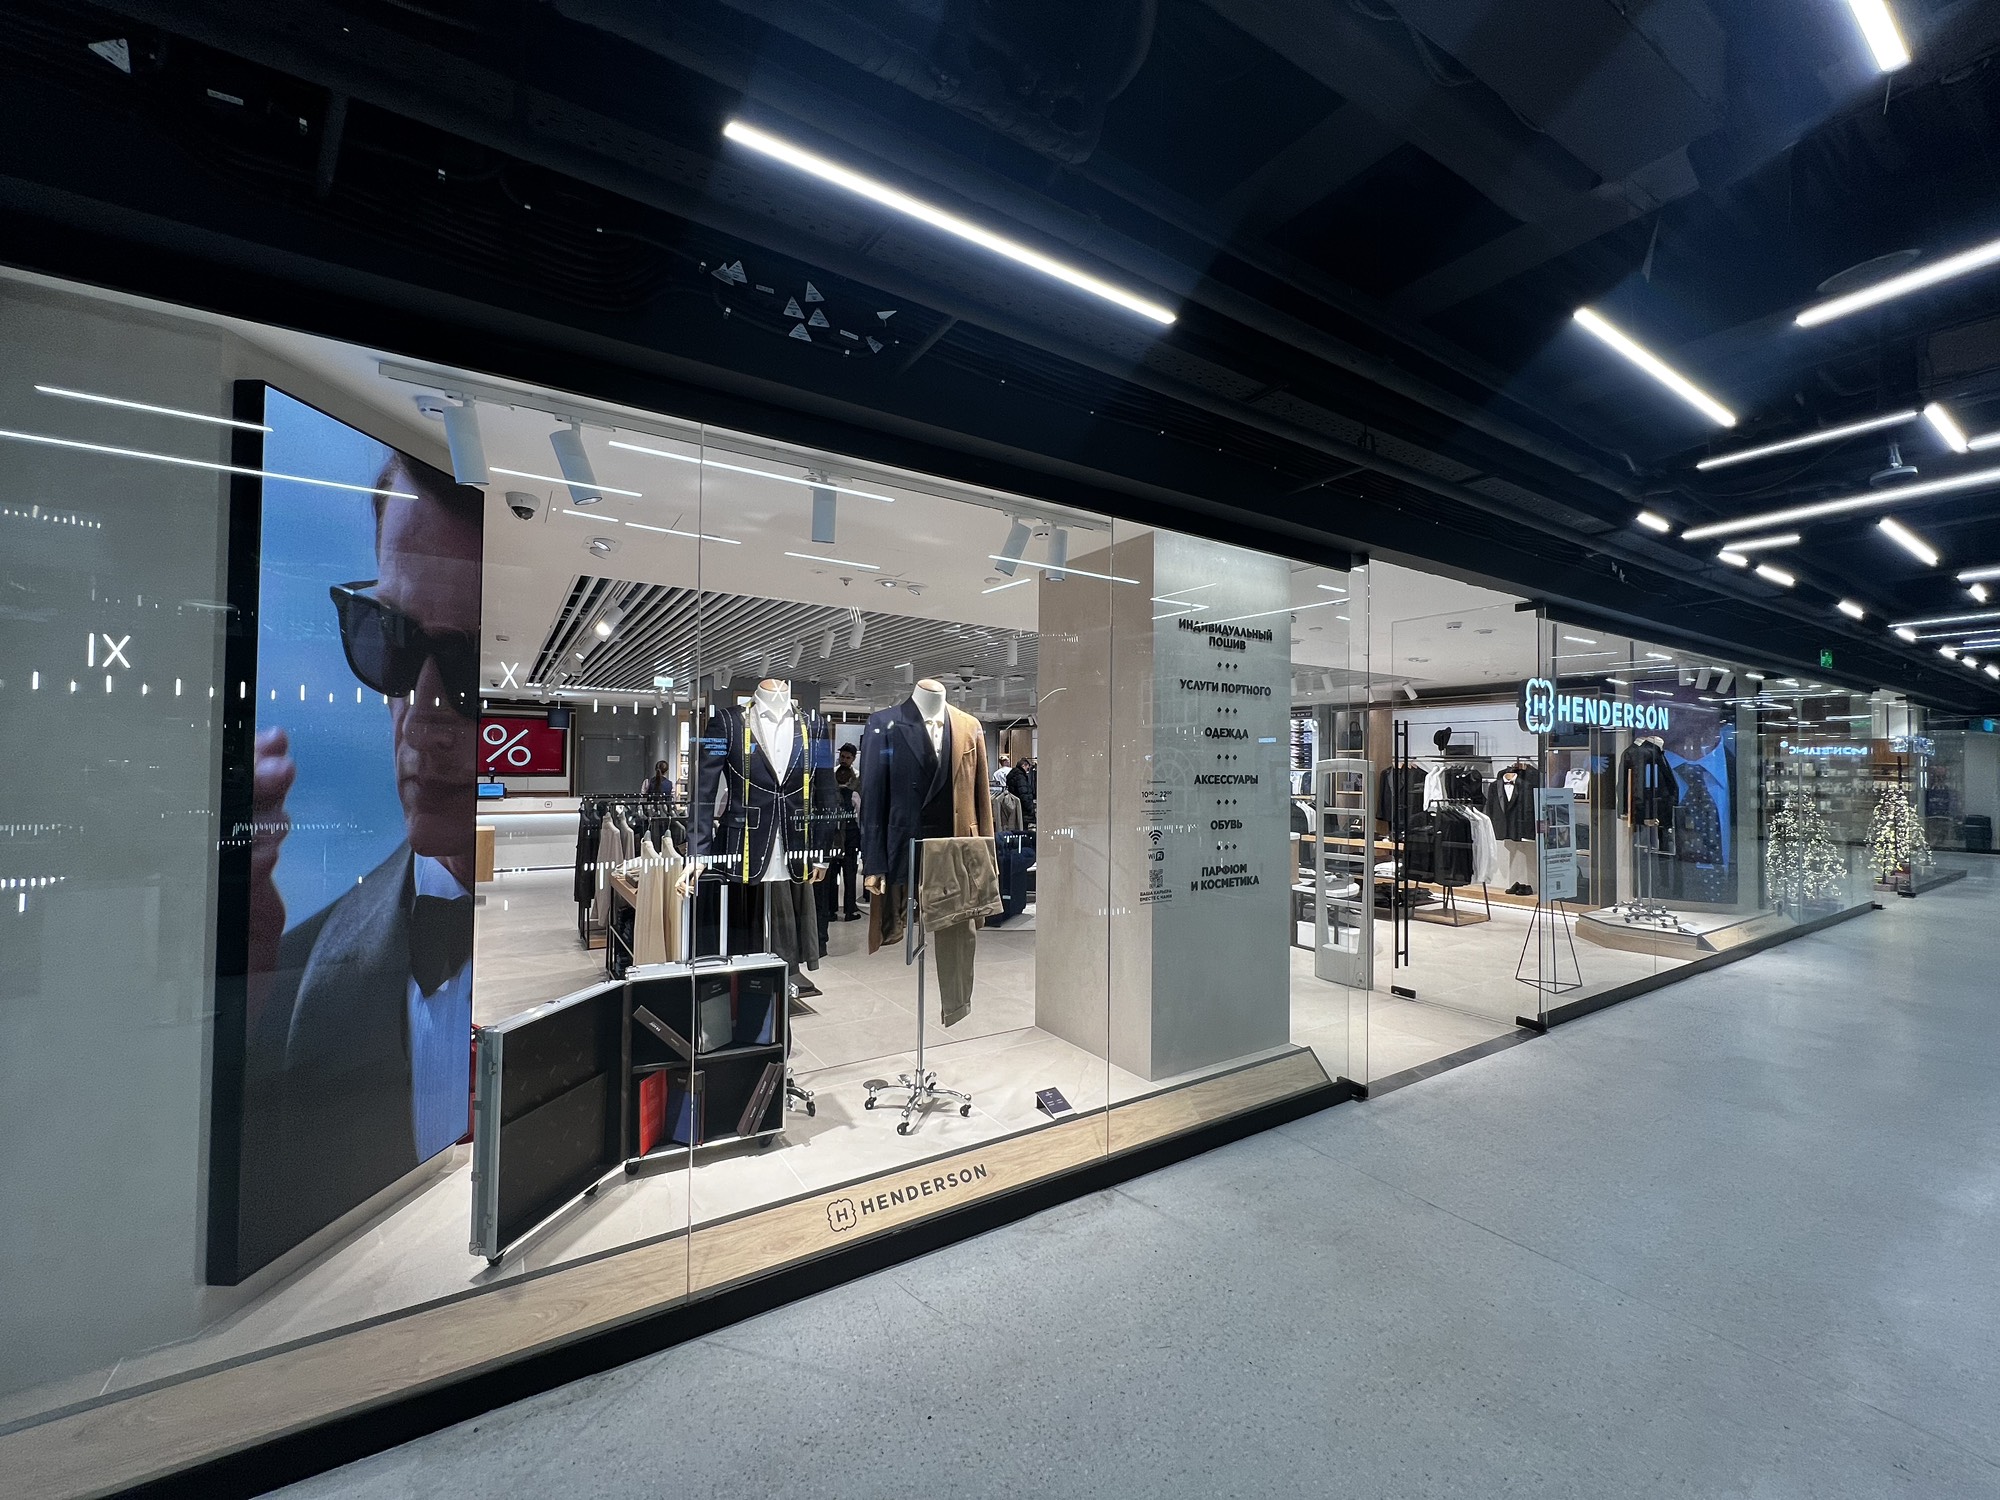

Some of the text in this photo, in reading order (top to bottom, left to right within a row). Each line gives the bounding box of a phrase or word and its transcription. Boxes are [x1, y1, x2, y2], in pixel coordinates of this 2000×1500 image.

[1179, 618, 1273, 641] ИНДИВИДУАЛЬНЫЙ
[1209, 636, 1246, 650] ПОШИВ
[1180, 679, 1272, 697] УСЛУГИ ПОРТНОГО
[1557, 694, 1670, 731] HENDERSON
[1204, 727, 1249, 740] ОДЕЖДА
[1194, 774, 1259, 785] АКСЕССУАРЫ
[1210, 819, 1243, 830] ОБУВЬ
[1201, 863, 1248, 877] ПАРФЮМ
[1191, 875, 1260, 891] И КОСМЕТИКА
[836, 1163, 988, 1223] H HENDERSON
